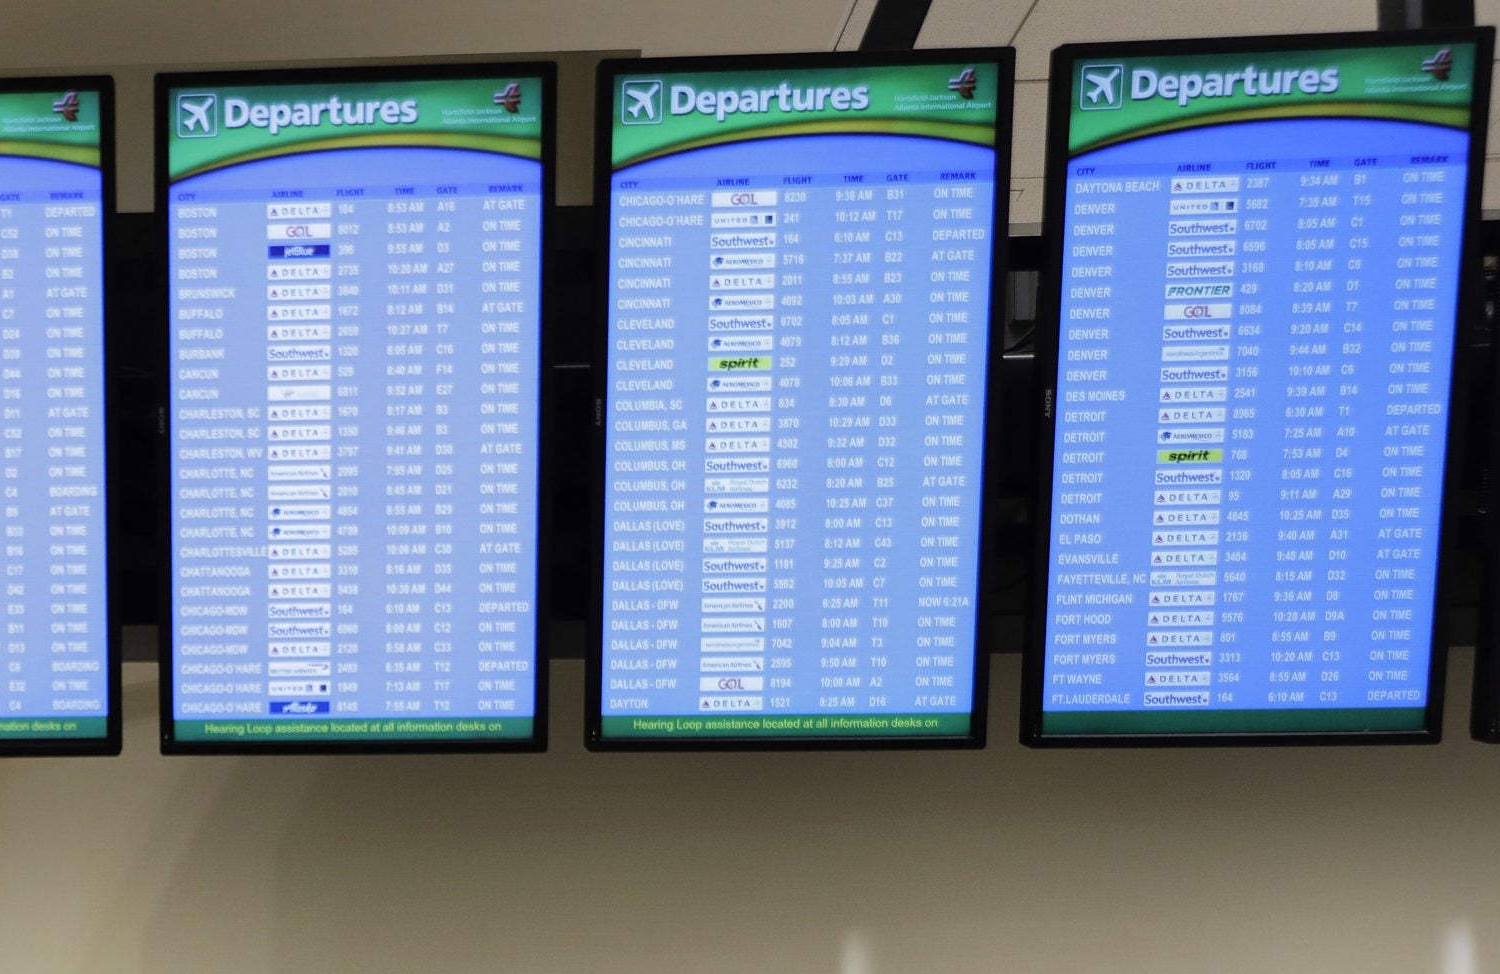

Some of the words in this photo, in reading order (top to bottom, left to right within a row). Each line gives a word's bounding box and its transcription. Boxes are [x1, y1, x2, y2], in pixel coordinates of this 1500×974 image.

[1130, 65, 1340, 106] Departures
[670, 82, 870, 122] Departures
[920, 102, 965, 111] International
[966, 101, 991, 110] Airport
[224, 96, 418, 135] Departures
[1076, 168, 1096, 176] CITY
[1177, 164, 1212, 173] AIRLINE
[1246, 162, 1276, 170] FLIGHT
[1309, 160, 1331, 168] TIME
[1354, 158, 1378, 167] GATE
[1410, 156, 1448, 165] REMARK
[620, 181, 638, 189] CITY
[717, 178, 750, 187] AIRLINE
[783, 177, 812, 185] FLIGHT
[843, 175, 864, 183] TIME
[886, 174, 909, 182] GATE
[940, 172, 977, 181] REMARK
[1075, 182, 1123, 194] DAYTONA
[1125, 180, 1160, 193] BEACH
[1186, 181, 1226, 191] DELTA
[619, 194, 704, 207] CHICAGO-O'HARE
[933, 188, 949, 199] ON
[951, 187, 974, 199] TIME
[177, 206, 217, 218] BOSTON
[280, 207, 318, 216] DELTA
[482, 200, 496, 211] AT
[498, 199, 525, 211] GATE
[1074, 203, 1116, 215] DENVER
[618, 236, 672, 248] CINCINNATI
[710, 236, 767, 248] Southwest
[932, 229, 985, 241] DEPARTED
[1070, 287, 1112, 299] DENVER
[1167, 285, 1231, 297] FRONTIER
[178, 308, 224, 320] BUFFALO
[281, 309, 318, 317] DELTA
[1068, 328, 1110, 340] DENVER
[1164, 327, 1223, 339] Southwest
[179, 348, 225, 360] BURBANK
[268, 348, 323, 359] Southwest
[481, 343, 496, 354] ON
[498, 342, 520, 353] TIME
[616, 359, 674, 371] CLEVELAND
[717, 358, 759, 371] spirit
[179, 368, 219, 380] CANCUN
[281, 369, 318, 378] DELTA
[1065, 391, 1086, 402] DES
[1087, 390, 1126, 402] MOINES
[1175, 391, 1215, 400] DELTA
[1064, 411, 1107, 423] DETROIT
[1173, 412, 1213, 420] DELTA
[1386, 404, 1442, 416] DEPARTED
[614, 420, 670, 433] COLUMBUS,
[672, 420, 687, 431] GA
[719, 422, 757, 430] DELTA
[1062, 452, 1105, 463] DETROIT
[1168, 450, 1211, 463] spirit
[613, 521, 652, 532] DALLAS
[653, 520, 685, 532] (LOVE)
[703, 521, 759, 532] Southwest
[1059, 534, 1072, 544] EL
[1074, 533, 1103, 544] PASO
[1167, 534, 1207, 543] DELTA
[1277, 530, 1298, 541] 9:40
[1299, 530, 1316, 541] AM
[1377, 529, 1392, 540] AT
[1393, 528, 1424, 540] GATE
[1058, 553, 1119, 565] EVANSVILLE
[1166, 555, 1205, 563] DELTA
[1057, 573, 1130, 586] FAYETTEVILLE,
[1133, 573, 1147, 584] NC
[281, 588, 318, 596] DELTA
[612, 600, 650, 611] DALLAS
[657, 600, 679, 610] DFW
[918, 597, 942, 608] NOW
[943, 597, 969, 608] 6:21A
[1056, 594, 1083, 605] FLINT
[1085, 593, 1133, 604] MICHIGAN
[1164, 595, 1203, 603] DELTA
[269, 606, 323, 617] Southwest
[1055, 614, 1082, 625] FORT
[1083, 613, 1112, 624] HOOD
[1163, 615, 1202, 624] DELTA
[1054, 634, 1081, 645] FORT
[1082, 633, 1117, 644] MYERS
[1161, 635, 1201, 644] DELTA
[1370, 631, 1387, 642] ON
[1389, 630, 1412, 641] TIME
[1052, 674, 1065, 684] FT
[1066, 673, 1103, 684] WAYNE
[1159, 675, 1199, 684] DELTA
[610, 698, 649, 709] DAYTON
[712, 700, 749, 708] DELTA
[914, 697, 928, 707] AT
[929, 697, 957, 707] GATE
[1051, 693, 1131, 704] FT.LAUDERDALE
[1145, 694, 1203, 705] Southwest
[1267, 692, 1288, 703] 6:10
[1289, 692, 1305, 703] AM
[1367, 691, 1421, 702] DEPARTED
[633, 719, 673, 732] Hearing
[677, 719, 702, 732] Loop
[705, 718, 760, 729] assistance
[763, 718, 801, 729] located
[804, 718, 814, 729] at
[816, 718, 828, 729] all
[830, 718, 888, 729] information
[891, 718, 922, 728] desks
[925, 720, 938, 728] on
